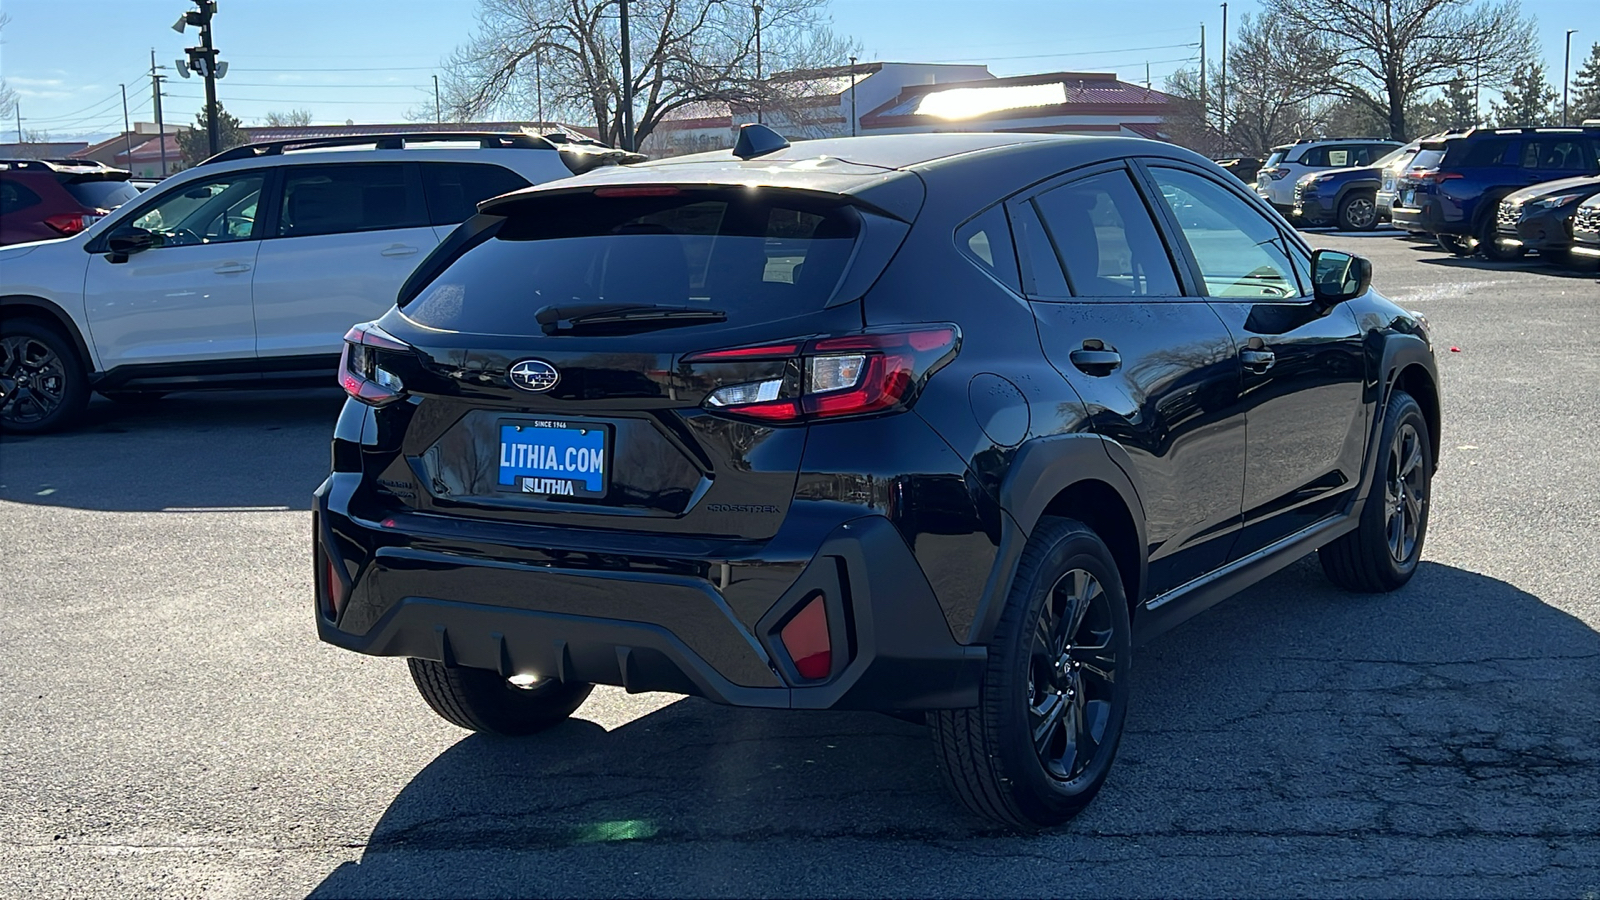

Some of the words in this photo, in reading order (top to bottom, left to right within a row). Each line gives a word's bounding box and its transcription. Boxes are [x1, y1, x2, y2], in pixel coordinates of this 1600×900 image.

[534, 420, 552, 428] SINCE
[553, 421, 567, 429] 1946
[500, 442, 604, 474] LITHIA.COM
[534, 478, 574, 496] LITHIA
[706, 503, 781, 514] CROSSTREK
